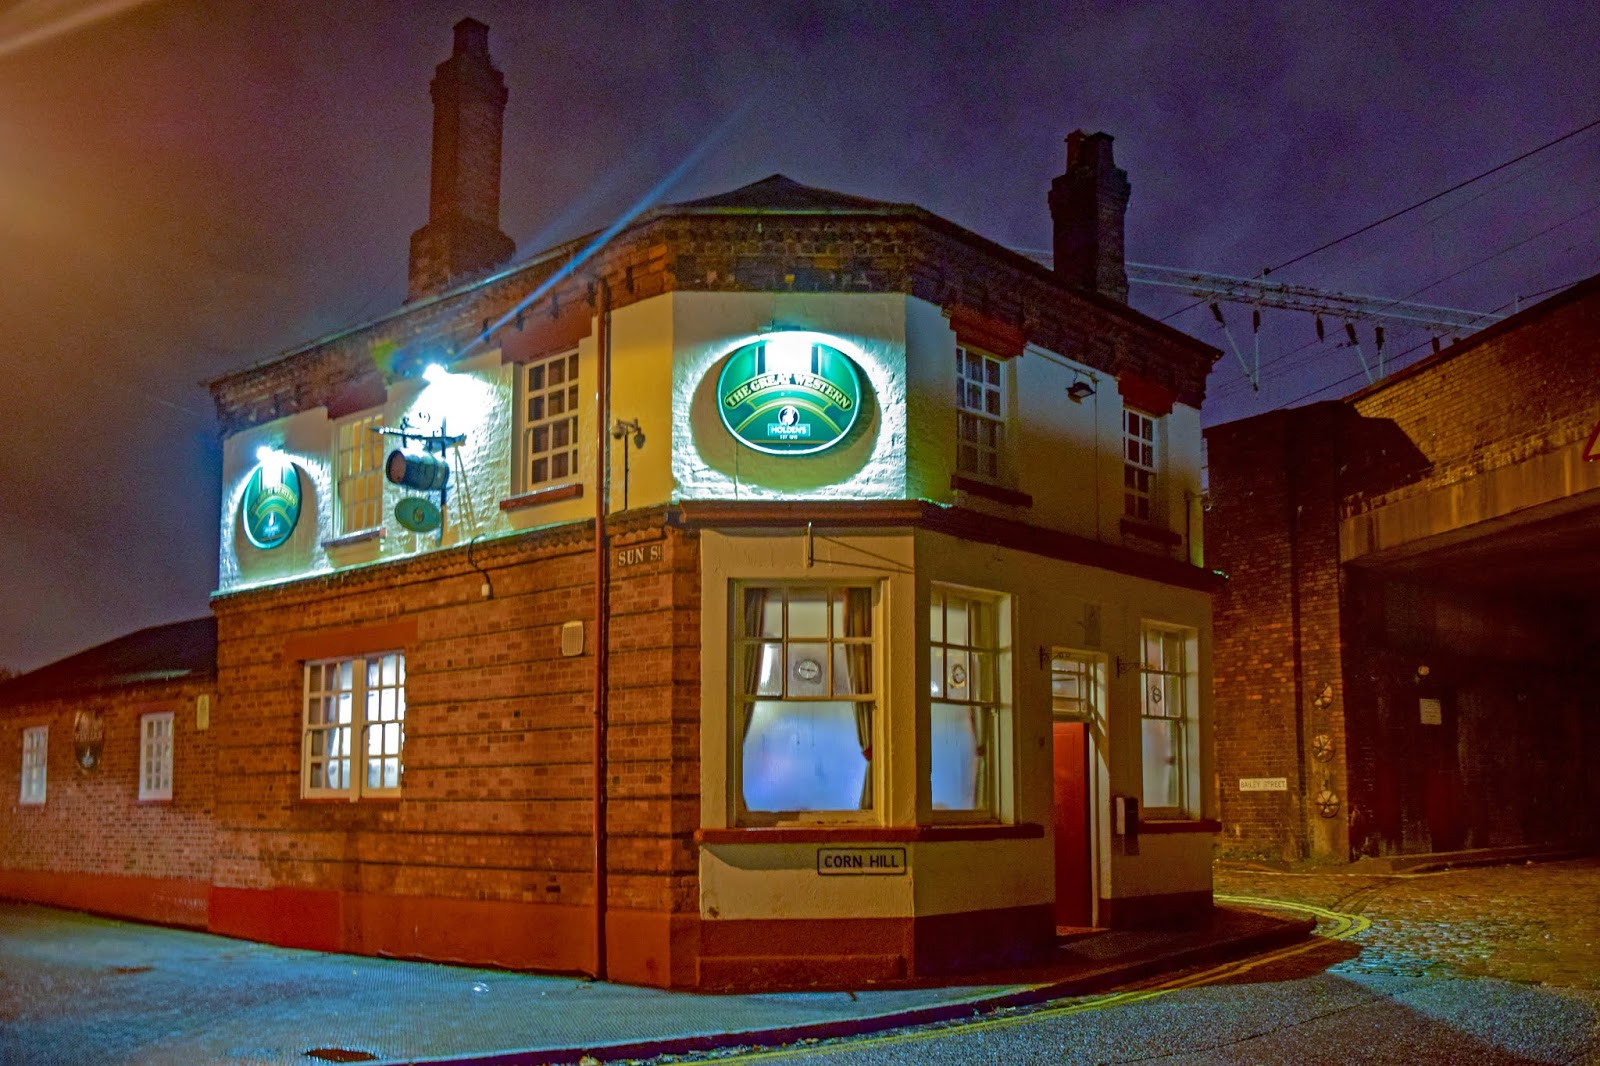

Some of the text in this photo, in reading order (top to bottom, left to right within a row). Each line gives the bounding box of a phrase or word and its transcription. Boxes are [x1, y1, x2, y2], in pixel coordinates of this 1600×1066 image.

[726, 373, 851, 409] THE GREAT WESTERN
[618, 547, 645, 567] SUN
[1263, 780, 1286, 788] STREET
[824, 855, 900, 868] CORN HILL
